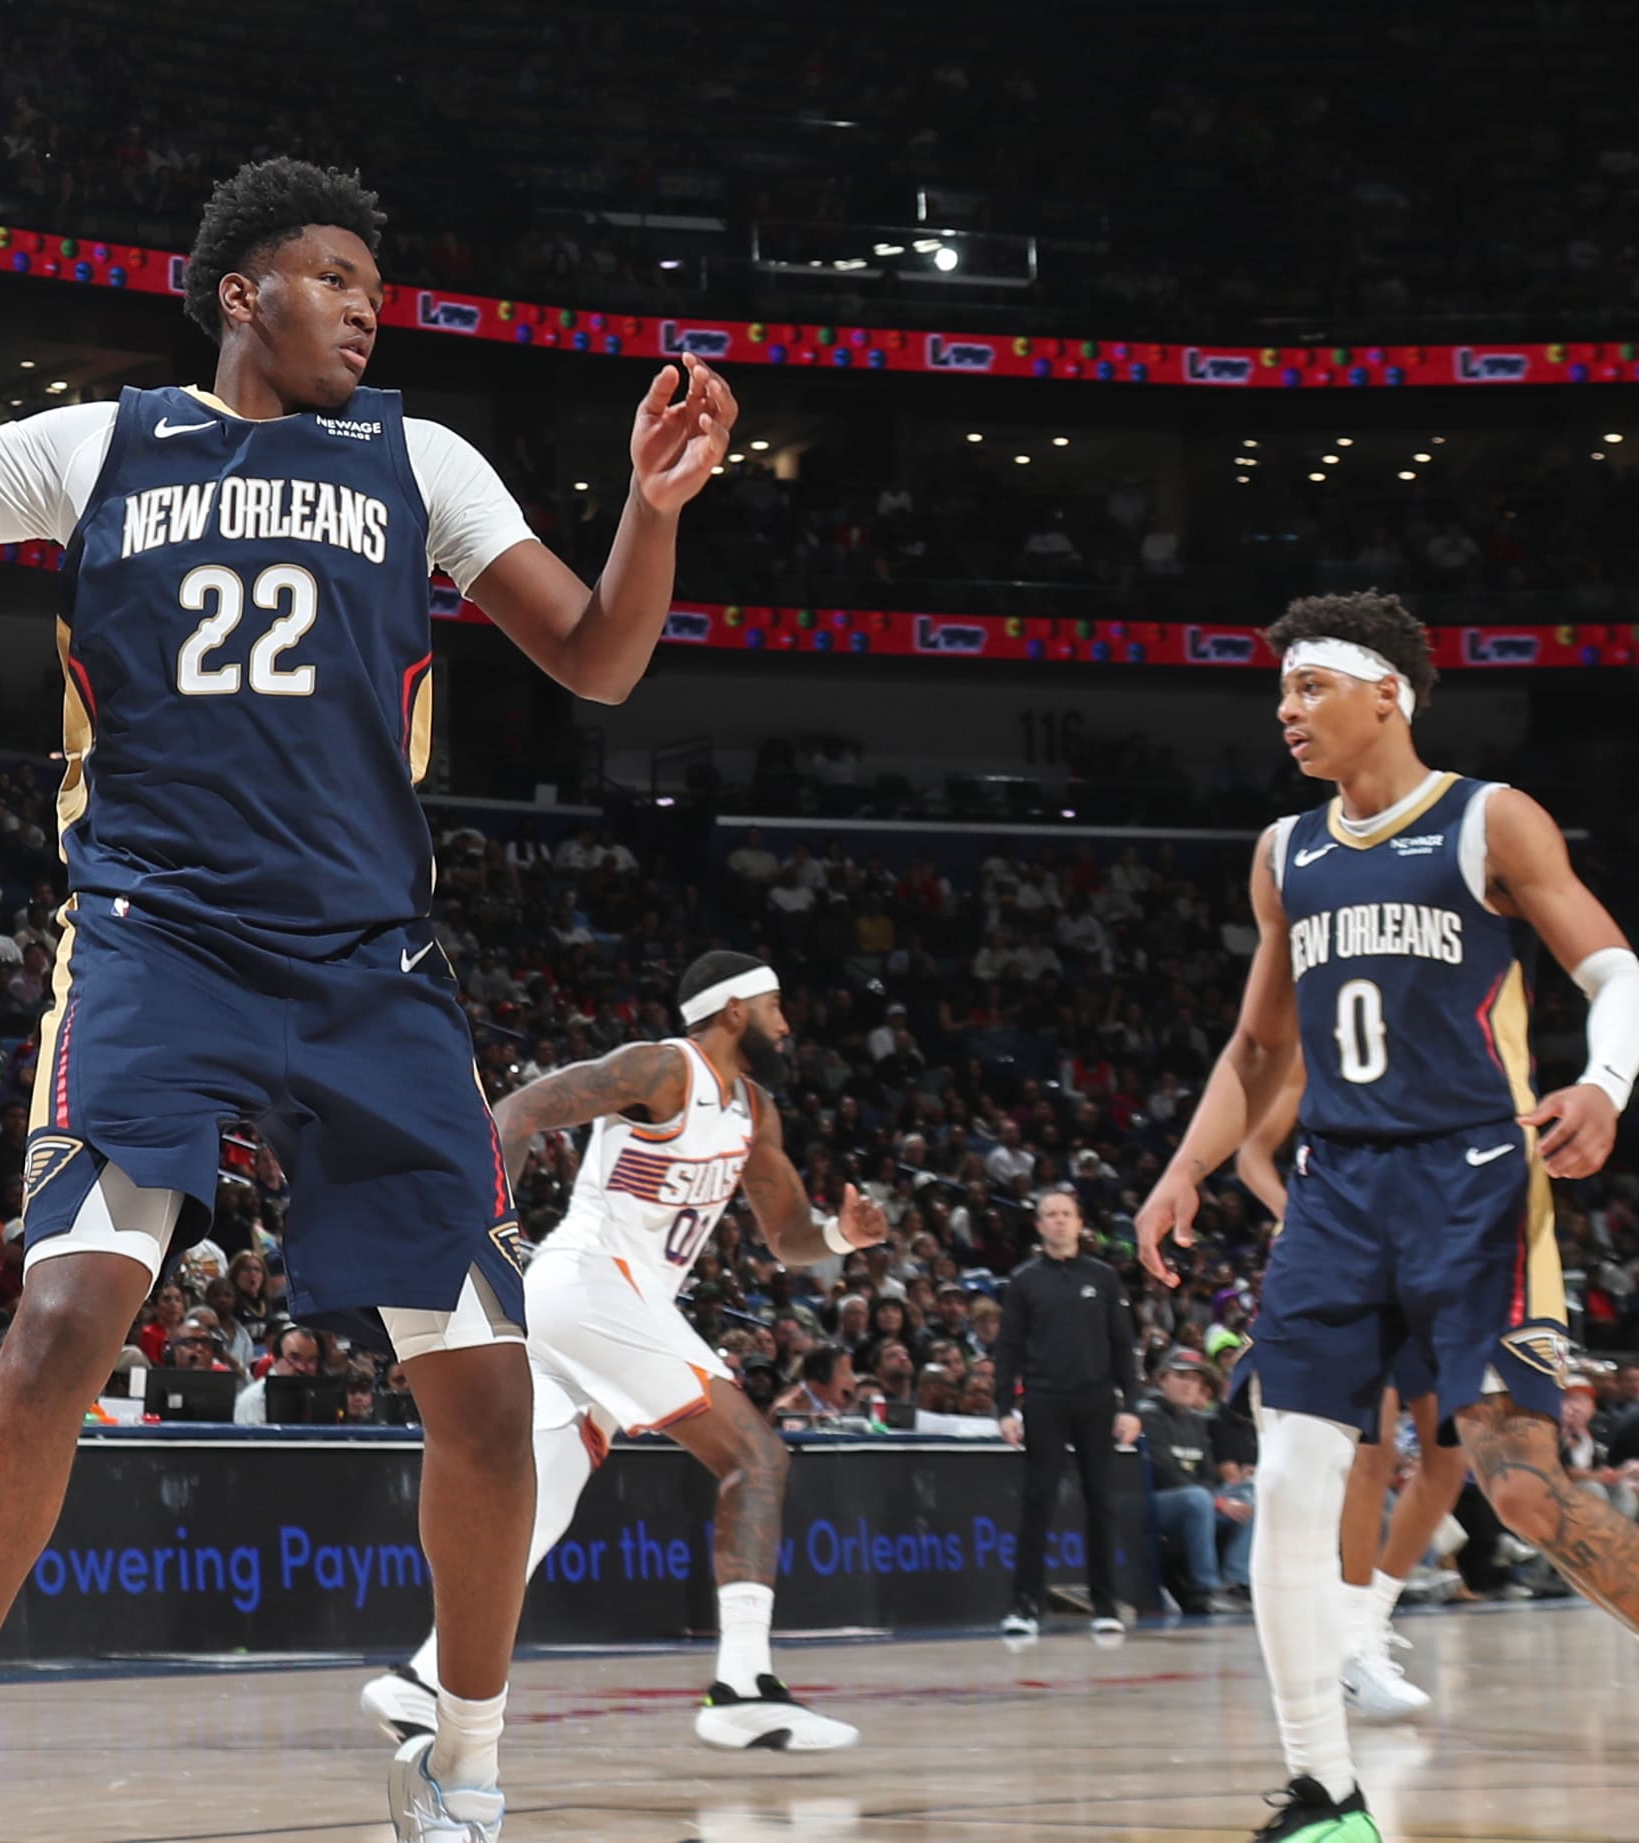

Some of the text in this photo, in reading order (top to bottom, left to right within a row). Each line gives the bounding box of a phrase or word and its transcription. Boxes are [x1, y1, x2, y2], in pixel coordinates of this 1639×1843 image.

[316, 414, 381, 433] NEWAGE
[328, 429, 371, 441] GARAGE
[121, 476, 388, 564] NEW ORLEANS
[177, 563, 318, 696] 22
[1290, 902, 1462, 983] EW ORLEANS
[1334, 978, 1388, 1084] 0
[34, 1526, 260, 1612] owering
[280, 1526, 433, 1608] Paym
[619, 1520, 690, 1580] the
[808, 1515, 962, 1576] Orleans
